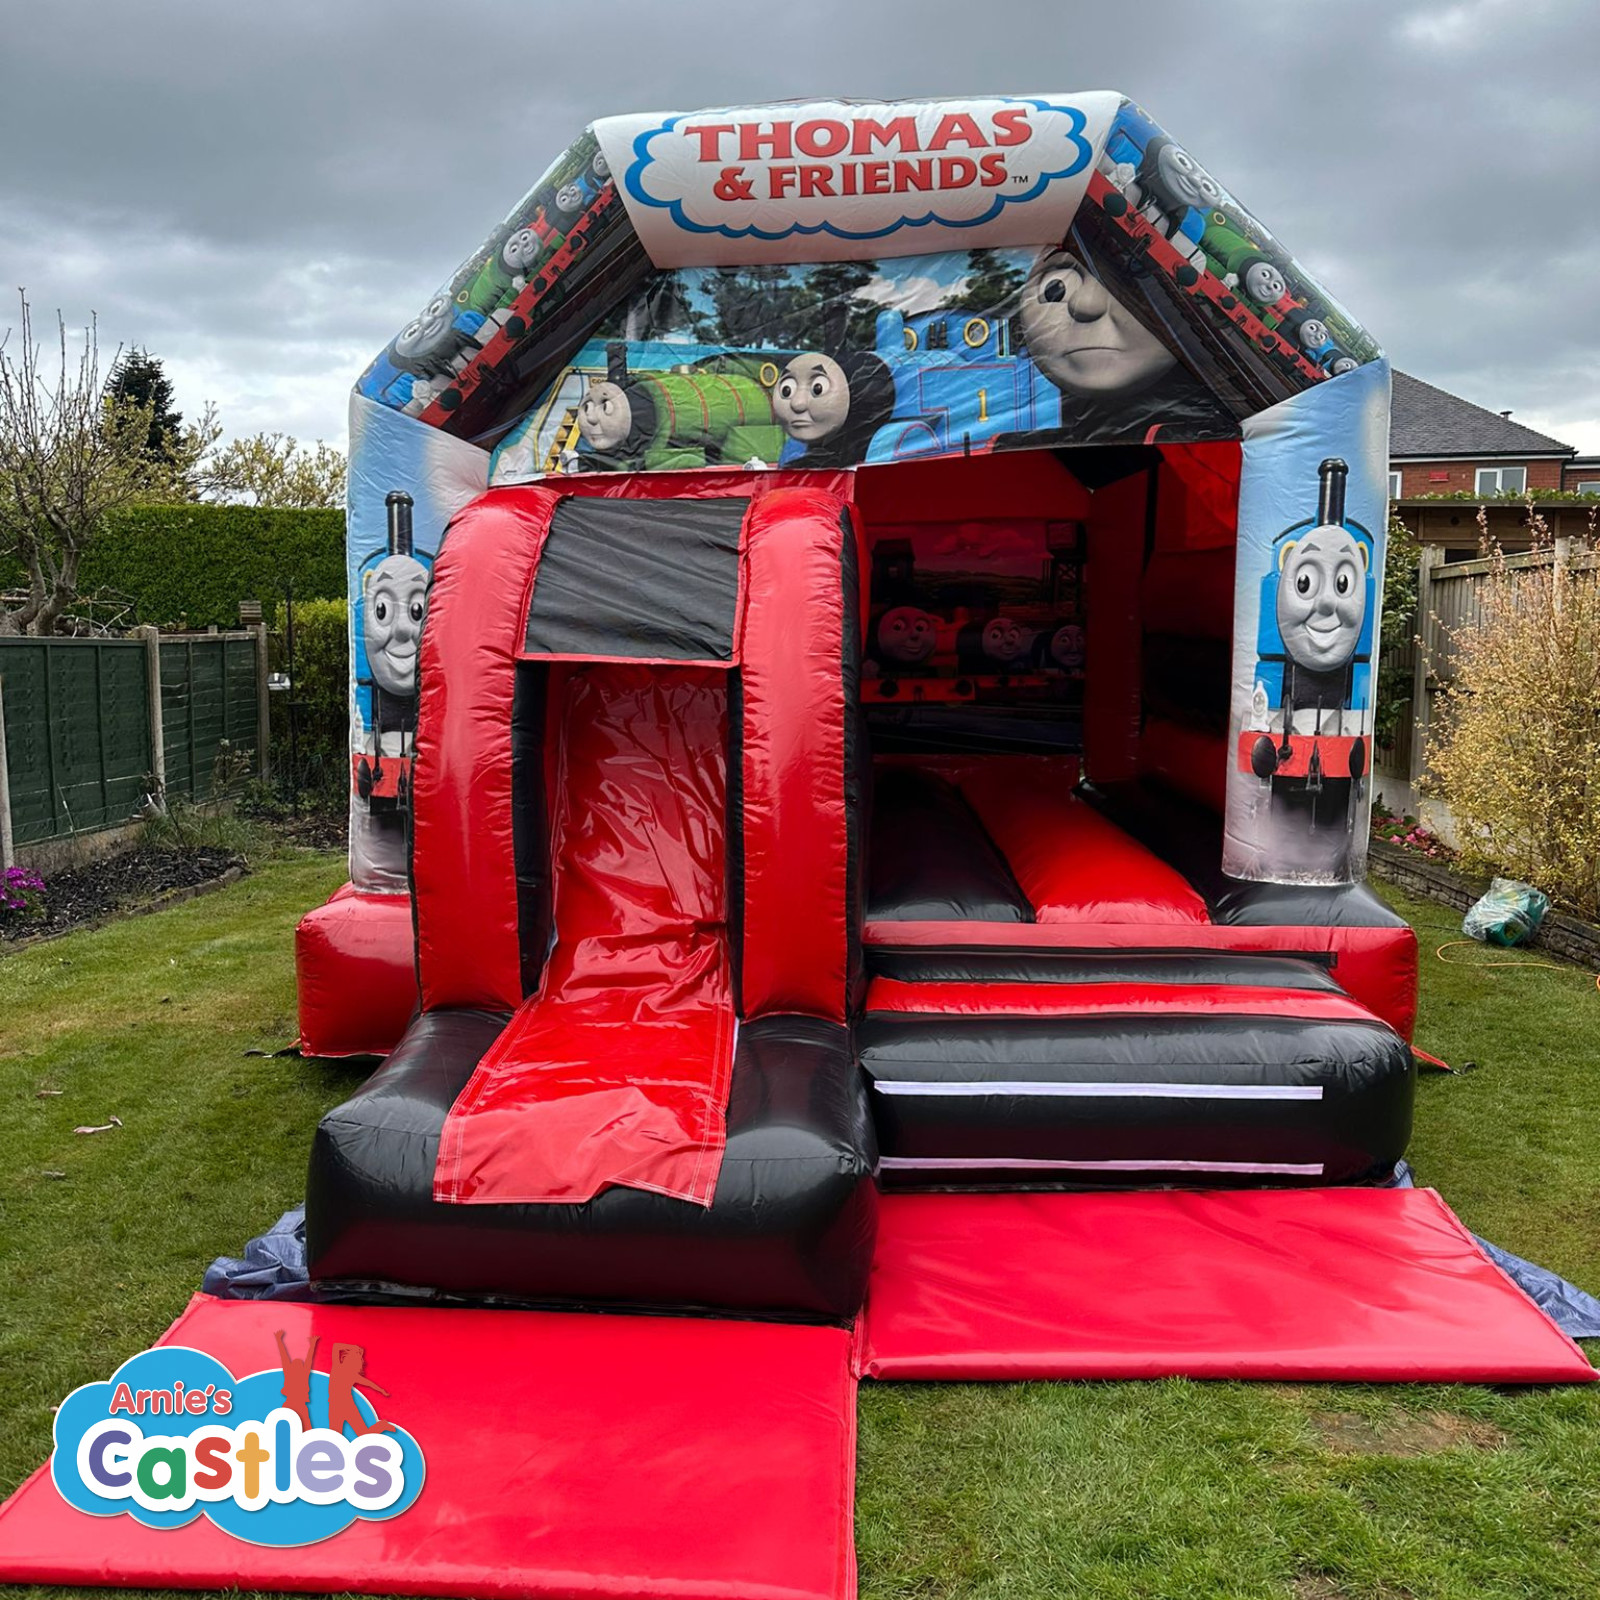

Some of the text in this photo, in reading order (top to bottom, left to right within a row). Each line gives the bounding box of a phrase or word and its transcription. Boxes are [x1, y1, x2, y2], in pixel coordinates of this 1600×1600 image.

[684, 108, 1032, 162] THOMAS
[713, 166, 758, 200] &
[768, 153, 1008, 199] FRIENDS
[977, 388, 989, 422] 1
